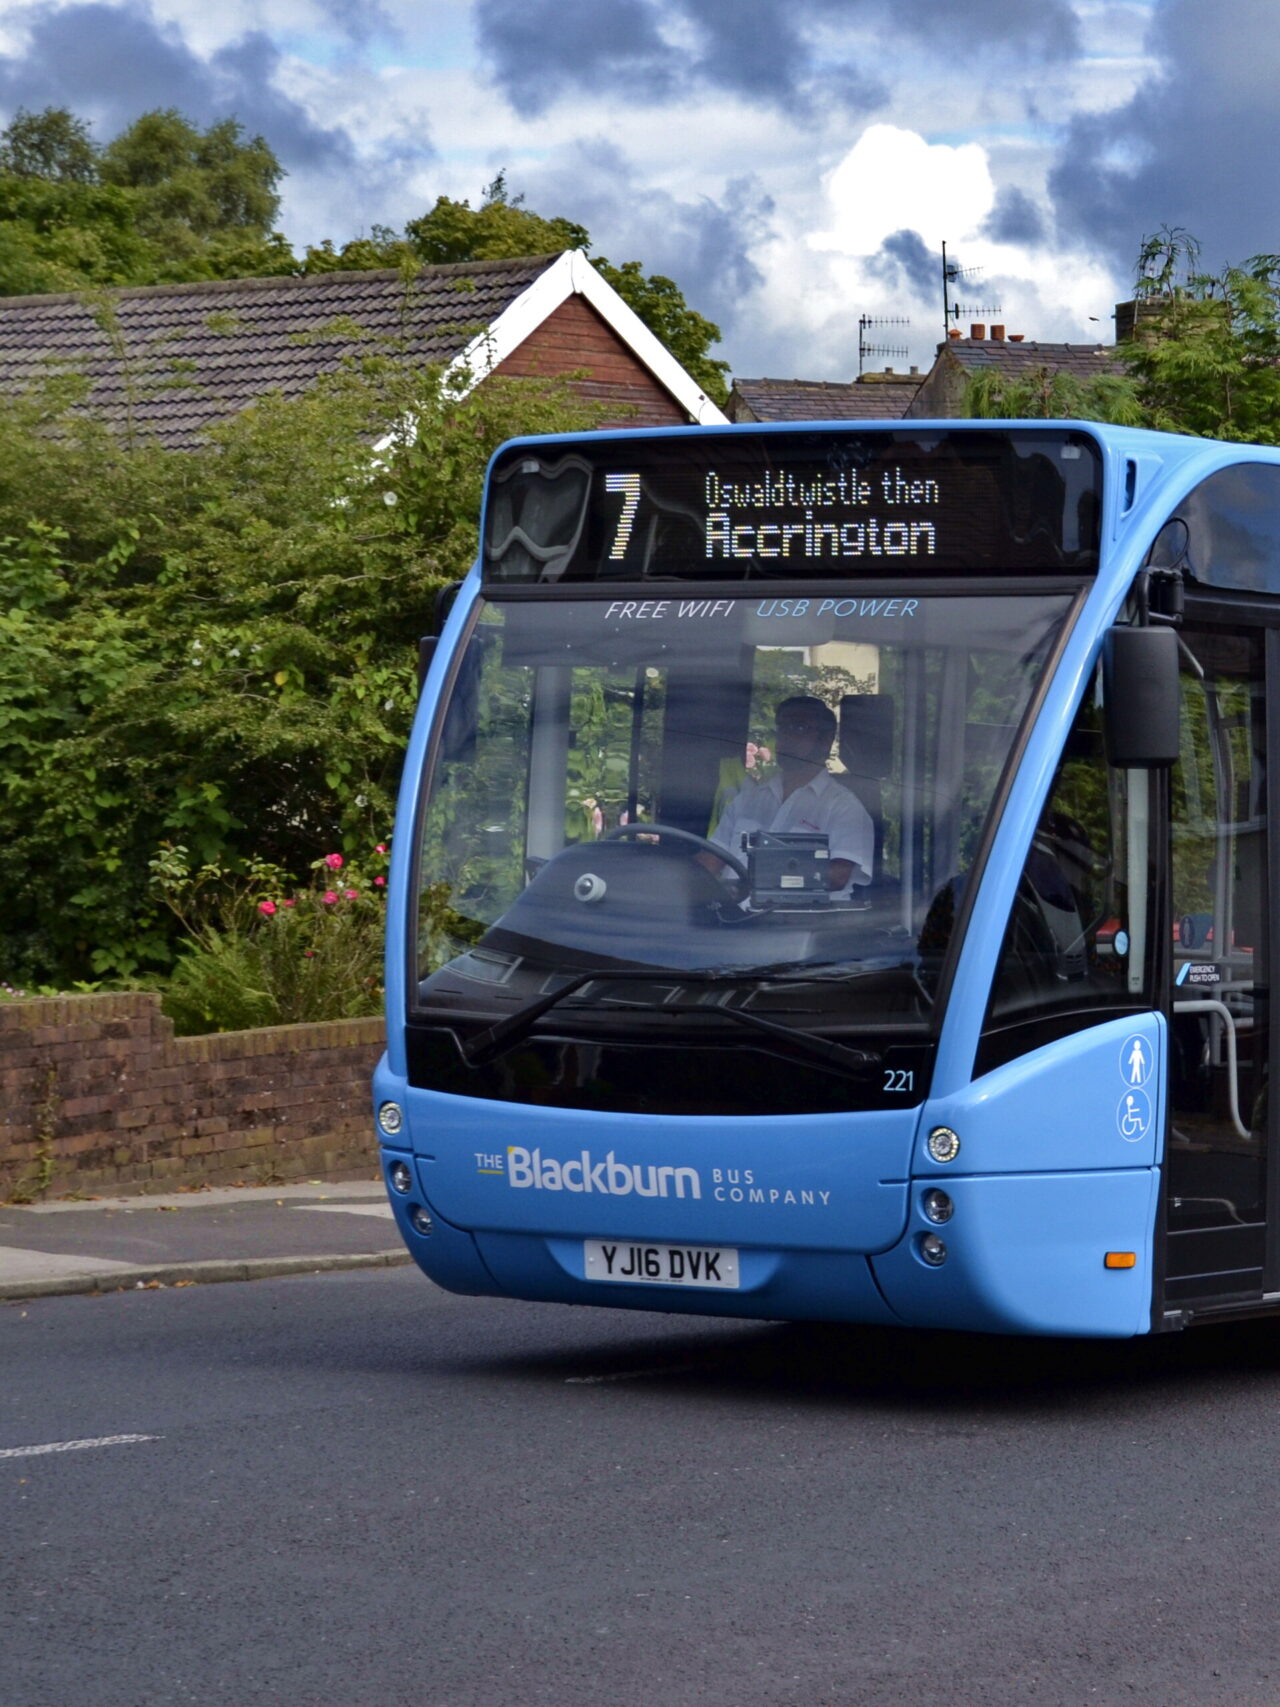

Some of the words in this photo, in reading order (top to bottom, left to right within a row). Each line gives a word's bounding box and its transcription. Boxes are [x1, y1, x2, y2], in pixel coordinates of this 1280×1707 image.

[705, 468, 871, 508] Oswaldtwistle
[881, 466, 939, 504] then
[605, 474, 641, 560] 7
[705, 510, 936, 558] Accrington
[604, 601, 671, 619] FREE
[677, 600, 736, 619] WIFI
[756, 600, 810, 617] USB
[816, 600, 919, 618] POWER
[883, 1069, 914, 1091] 221
[474, 1153, 503, 1170] THE
[507, 1146, 702, 1200] Blackburn
[713, 1168, 755, 1185] BUS
[713, 1187, 832, 1206] COMPANY
[601, 1245, 661, 1278] YJ16
[668, 1249, 722, 1282] DVK
